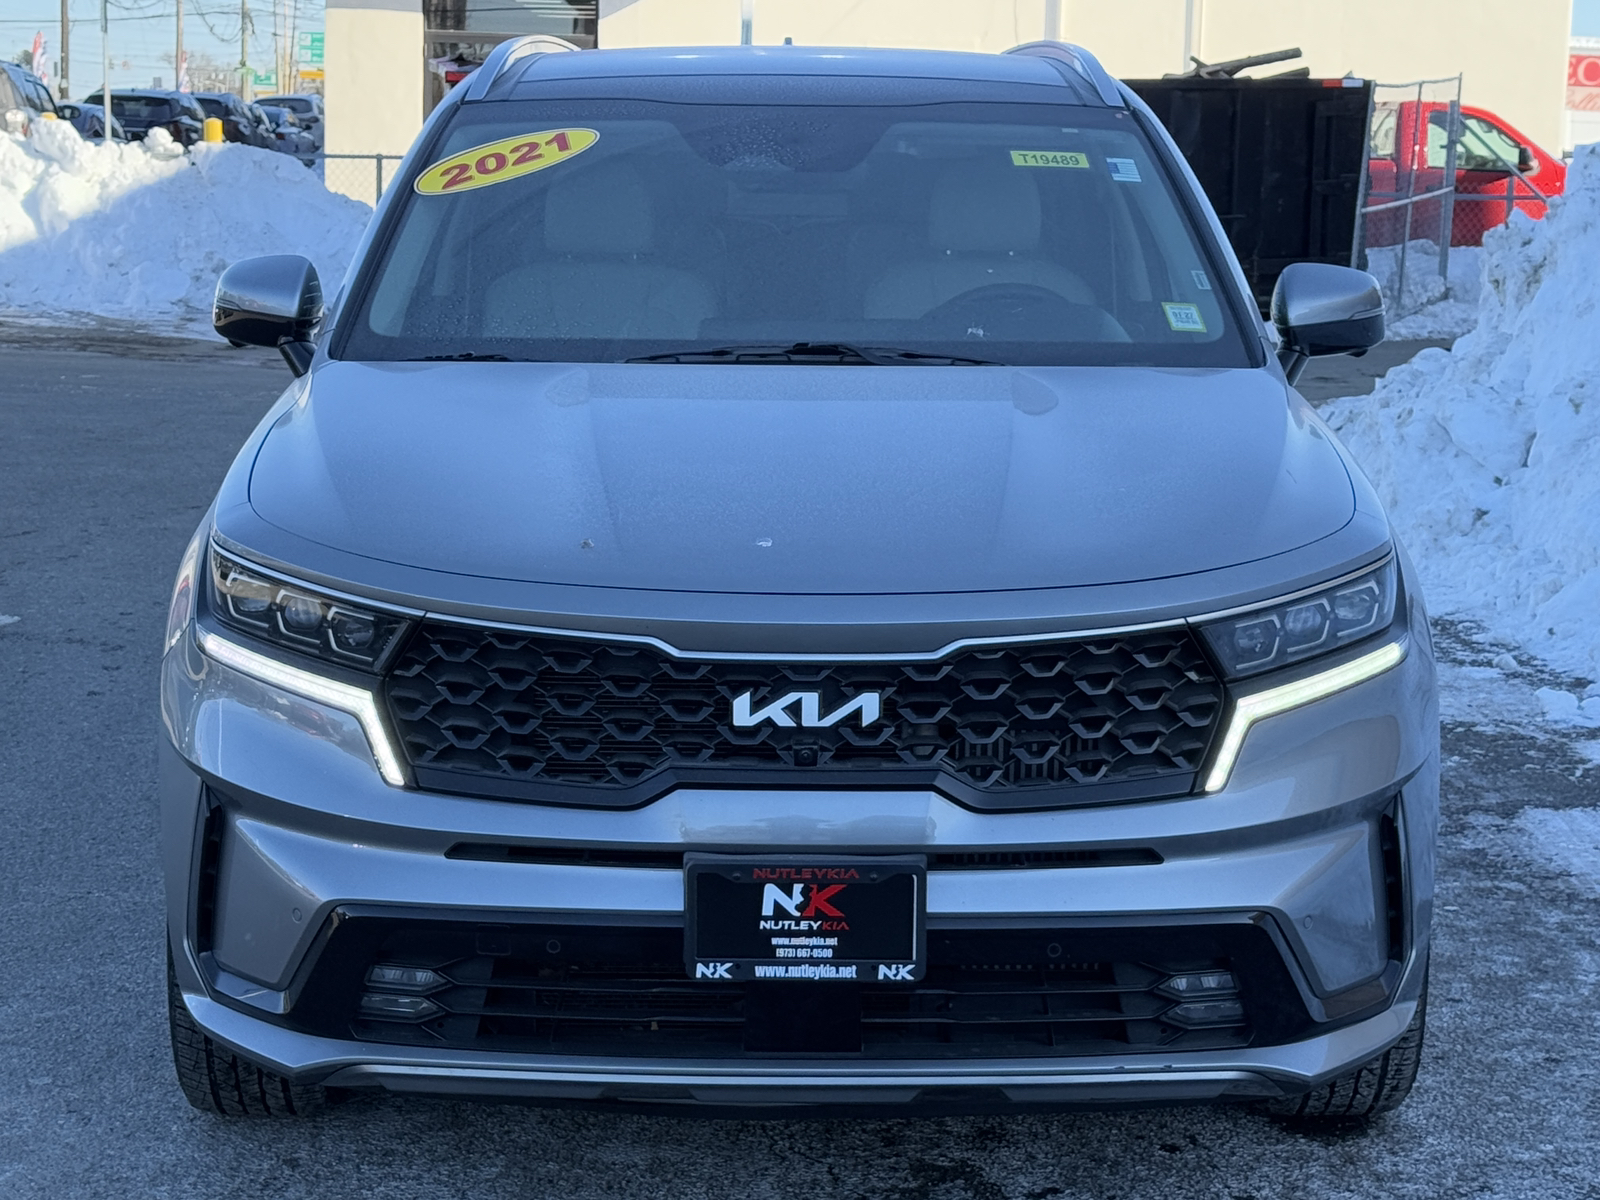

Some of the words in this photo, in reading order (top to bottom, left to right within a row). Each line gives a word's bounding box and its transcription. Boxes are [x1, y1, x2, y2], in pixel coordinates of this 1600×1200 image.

[439, 131, 572, 190] 2021
[1017, 153, 1080, 166] T19489
[732, 691, 880, 728] KIA
[775, 948, 796, 958] (973)
[796, 948, 833, 958] 667-0500
[754, 963, 857, 980] www.nutleykia.net
